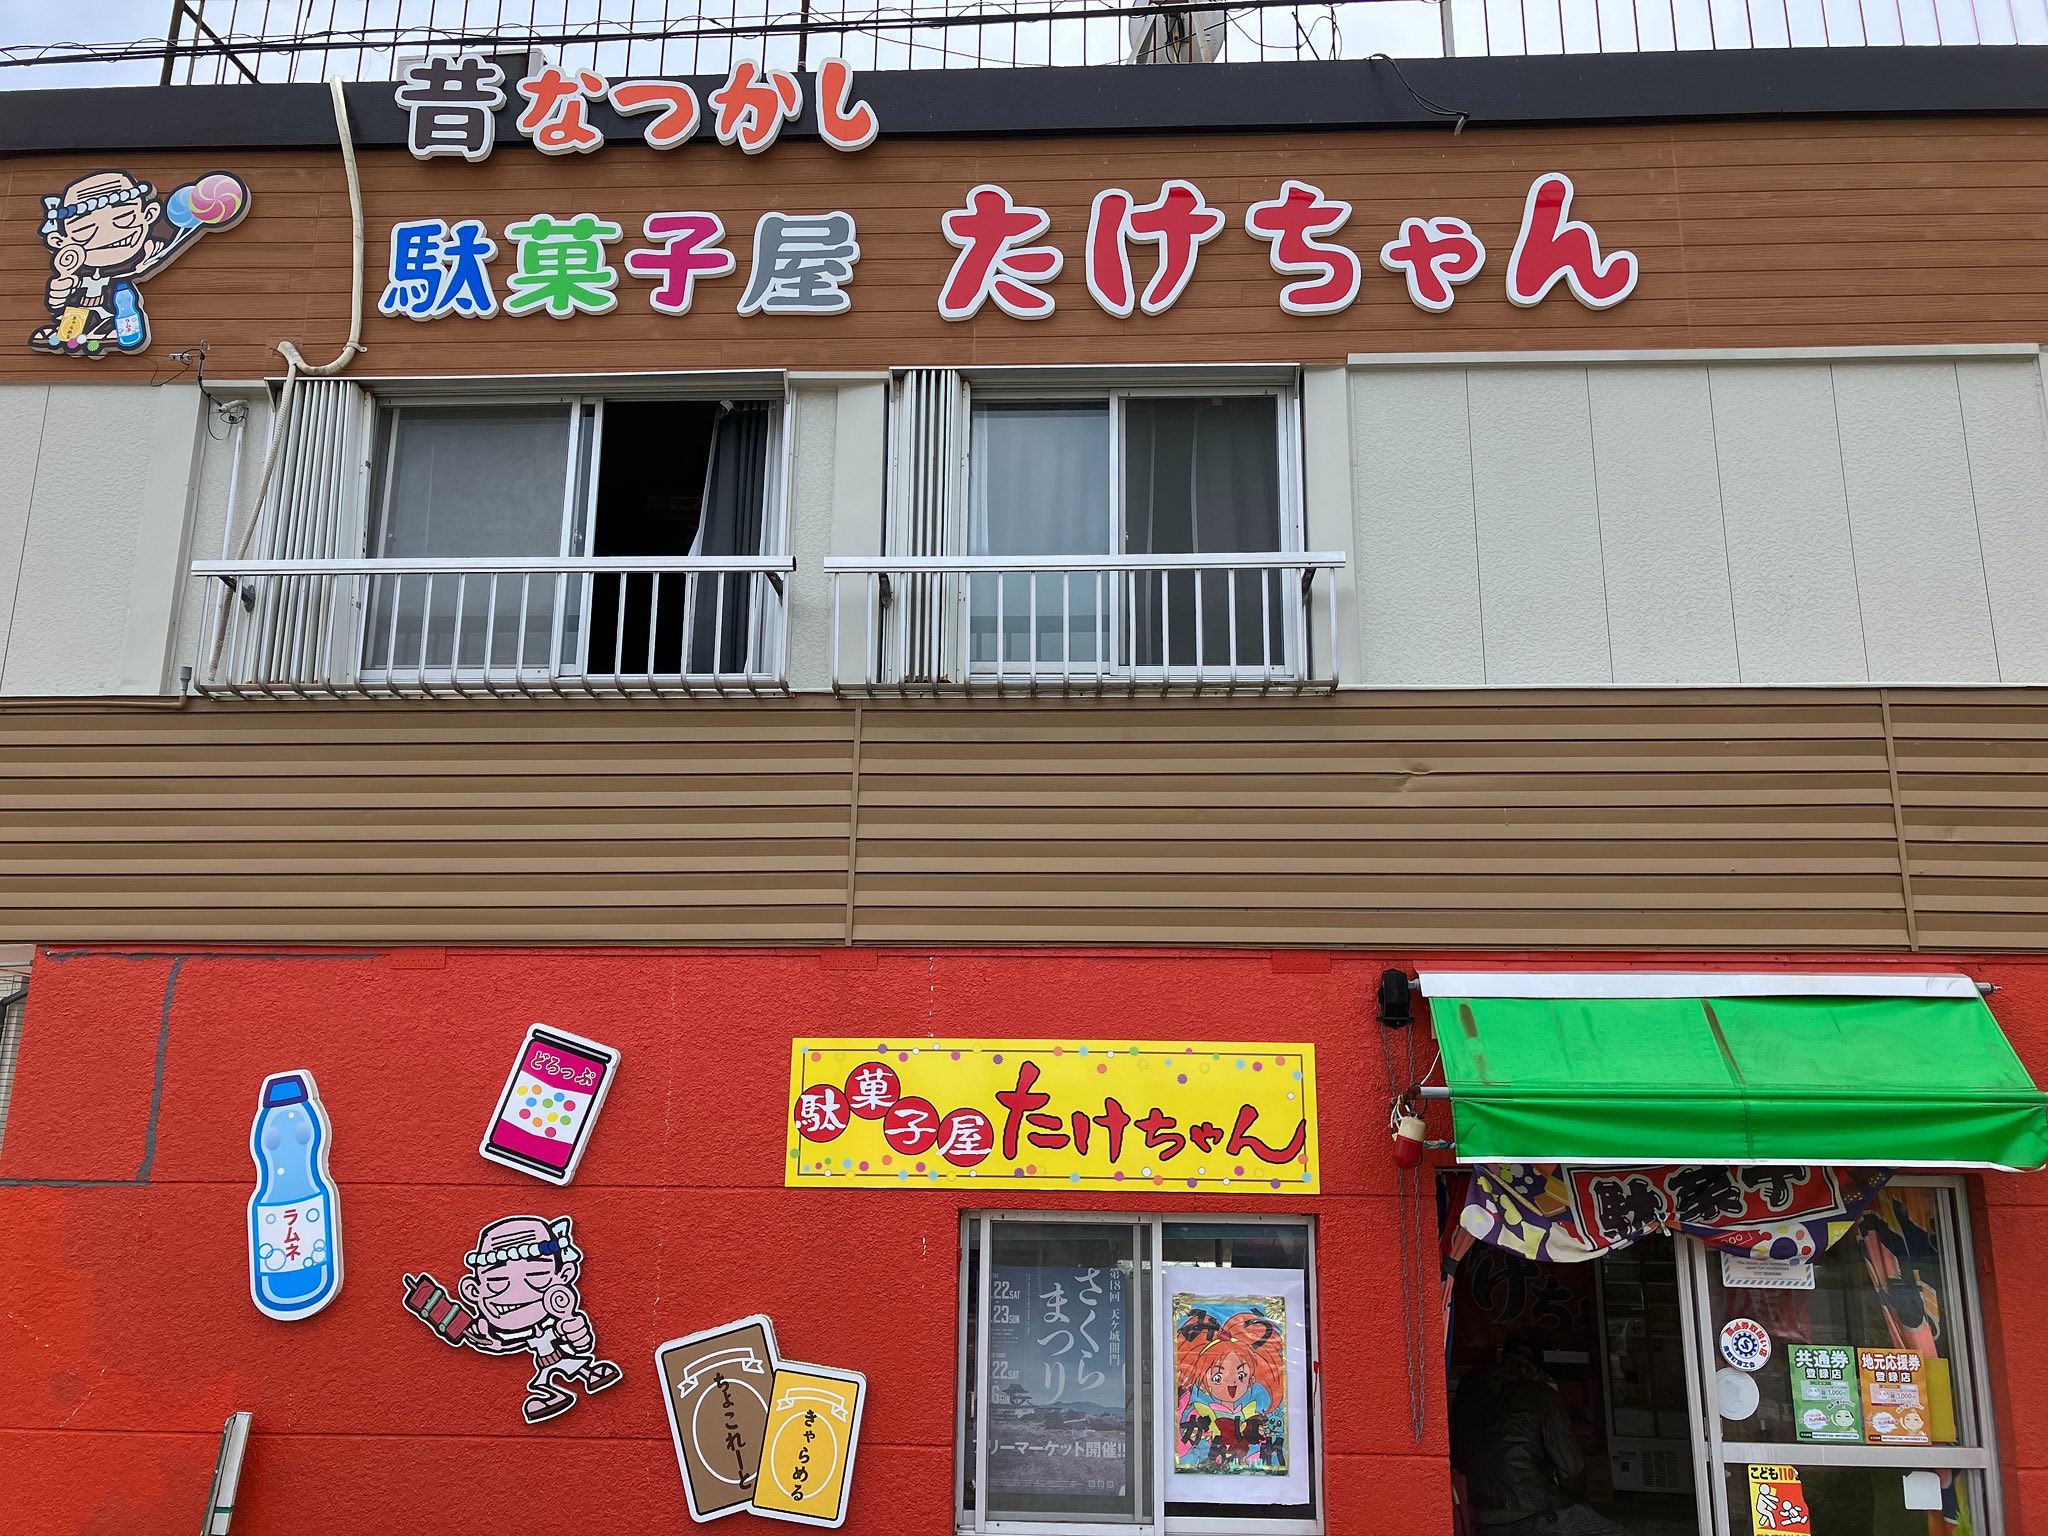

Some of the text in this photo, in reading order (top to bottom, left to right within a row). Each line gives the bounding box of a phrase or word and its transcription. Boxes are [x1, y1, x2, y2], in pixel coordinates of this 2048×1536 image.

[398, 57, 878, 156] 昔なつかし
[381, 176, 1635, 315] 駄菓子屋 たけちゃん
[531, 1050, 596, 1086] どろっぷ
[794, 1060, 1307, 1164] 駄菓子屋 たけちゃん
[283, 1208, 301, 1261] ラムネ
[1036, 1282, 1075, 1406] まつり
[1074, 1267, 1105, 1391] さくら
[1795, 1349, 1849, 1369] 共通券
[1861, 1352, 1921, 1371] 地元応援券
[1805, 1368, 1843, 1380] 登録店
[1875, 1371, 1912, 1383] 登録店
[713, 1372, 752, 1490] ちょこれーと
[790, 1409, 818, 1501] きゃらめる
[1750, 1466, 1801, 1481] こども110
